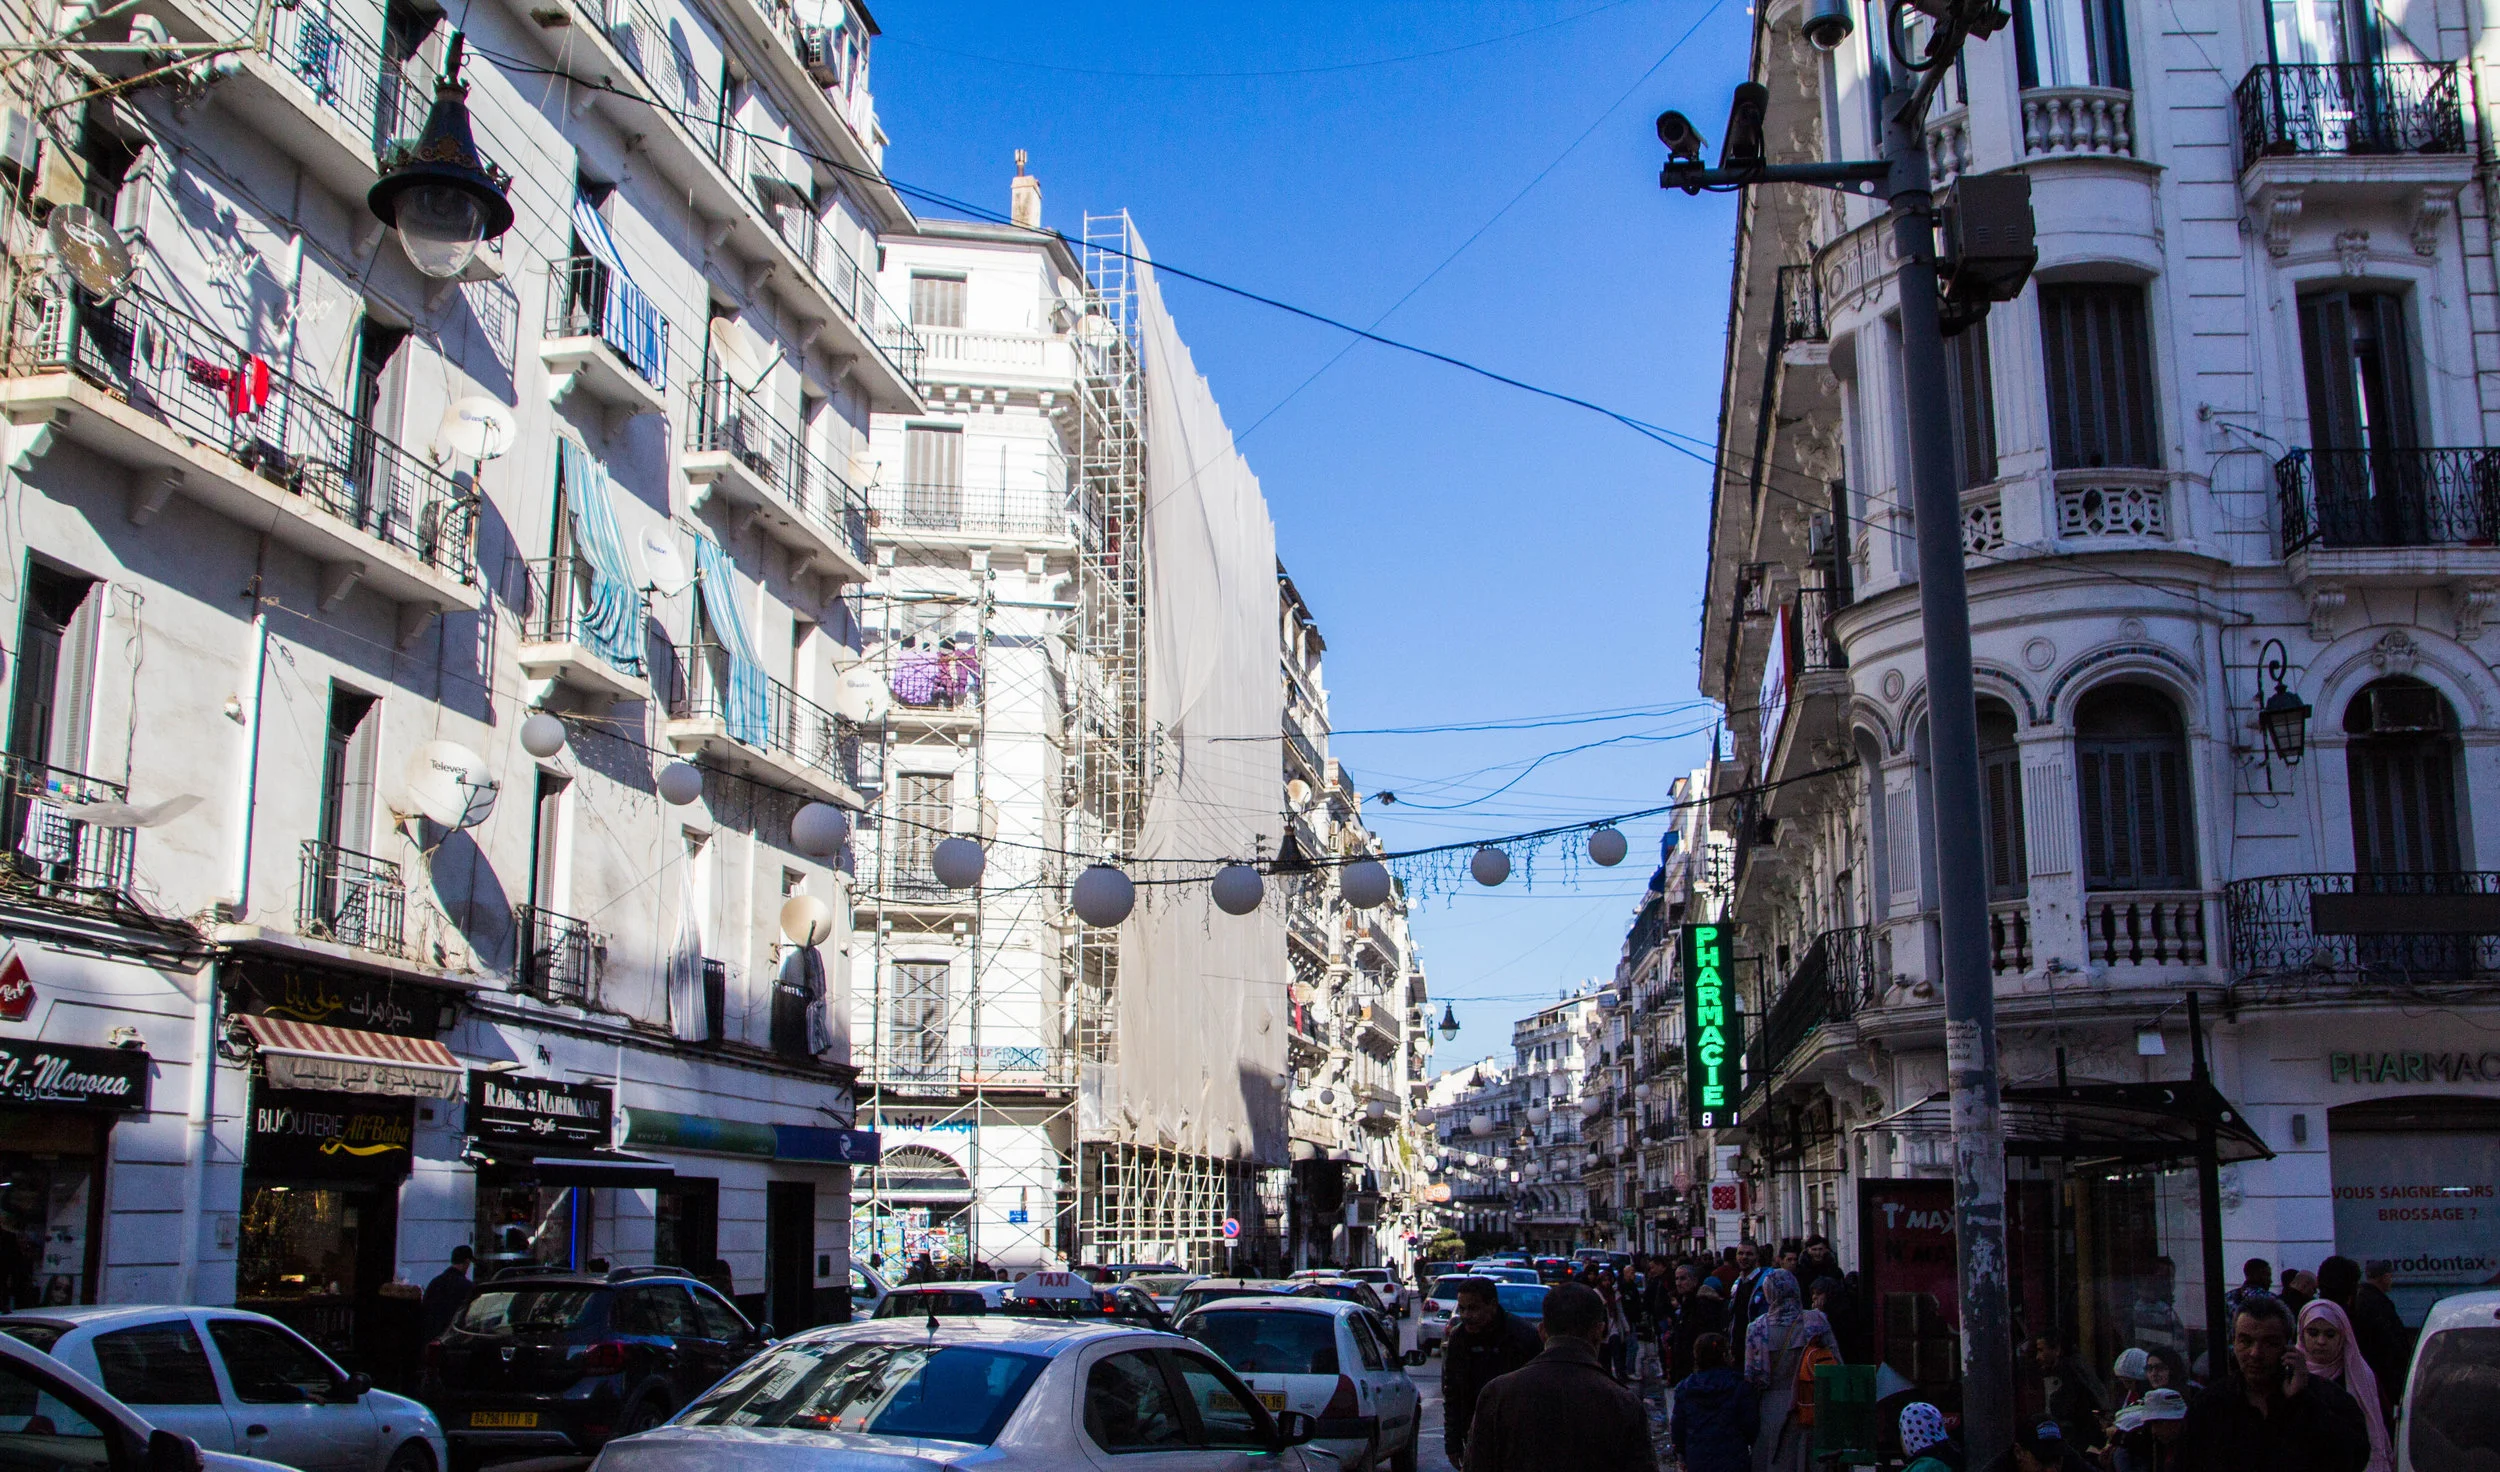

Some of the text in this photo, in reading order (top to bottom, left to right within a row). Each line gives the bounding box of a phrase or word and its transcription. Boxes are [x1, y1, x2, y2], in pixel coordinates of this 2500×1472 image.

[430, 759, 468, 775] Televes
[348, 991, 412, 1028] مجوهرات
[1695, 926, 1725, 1106] PHARMACIE
[962, 1046, 993, 1057] ECLE
[526, 1091, 537, 1112] &
[537, 1088, 600, 1119] NARIMANE
[257, 1106, 344, 1138] BIJOUTERIE
[530, 1117, 557, 1135] Style
[2332, 1186, 2375, 1200] VOUS
[2380, 1185, 2450, 1199] SAIGNEZ
[2454, 1185, 2494, 1198] LORS
[2378, 1207, 2478, 1221] BROSSAGE ?
[1037, 1271, 1070, 1287] TAXI
